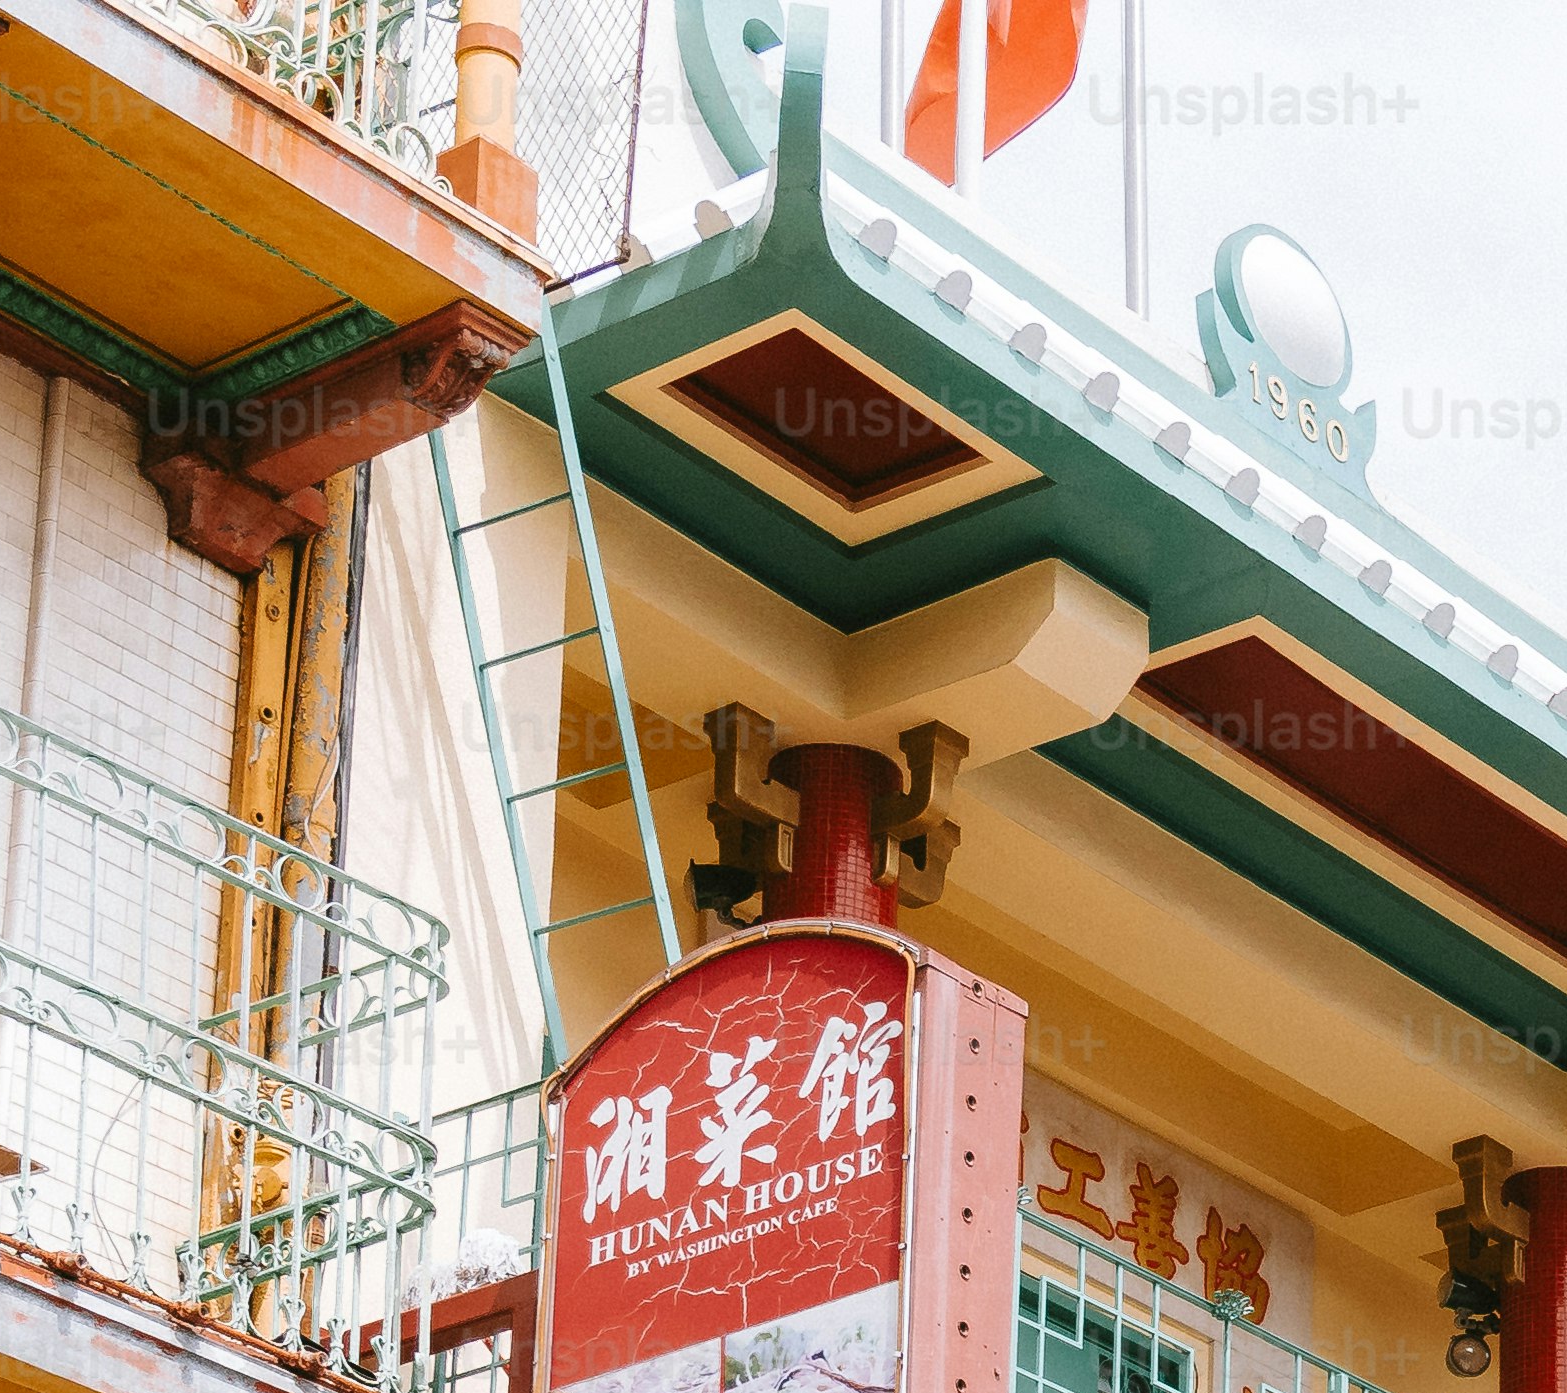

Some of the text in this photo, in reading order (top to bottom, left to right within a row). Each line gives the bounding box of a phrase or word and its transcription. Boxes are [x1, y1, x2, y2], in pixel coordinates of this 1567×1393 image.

[1248, 360, 1350, 463] 1960
[588, 1144, 885, 1269] HUNAN HOUSE
[627, 1197, 838, 1279] BY WASHINGTON CAFE
